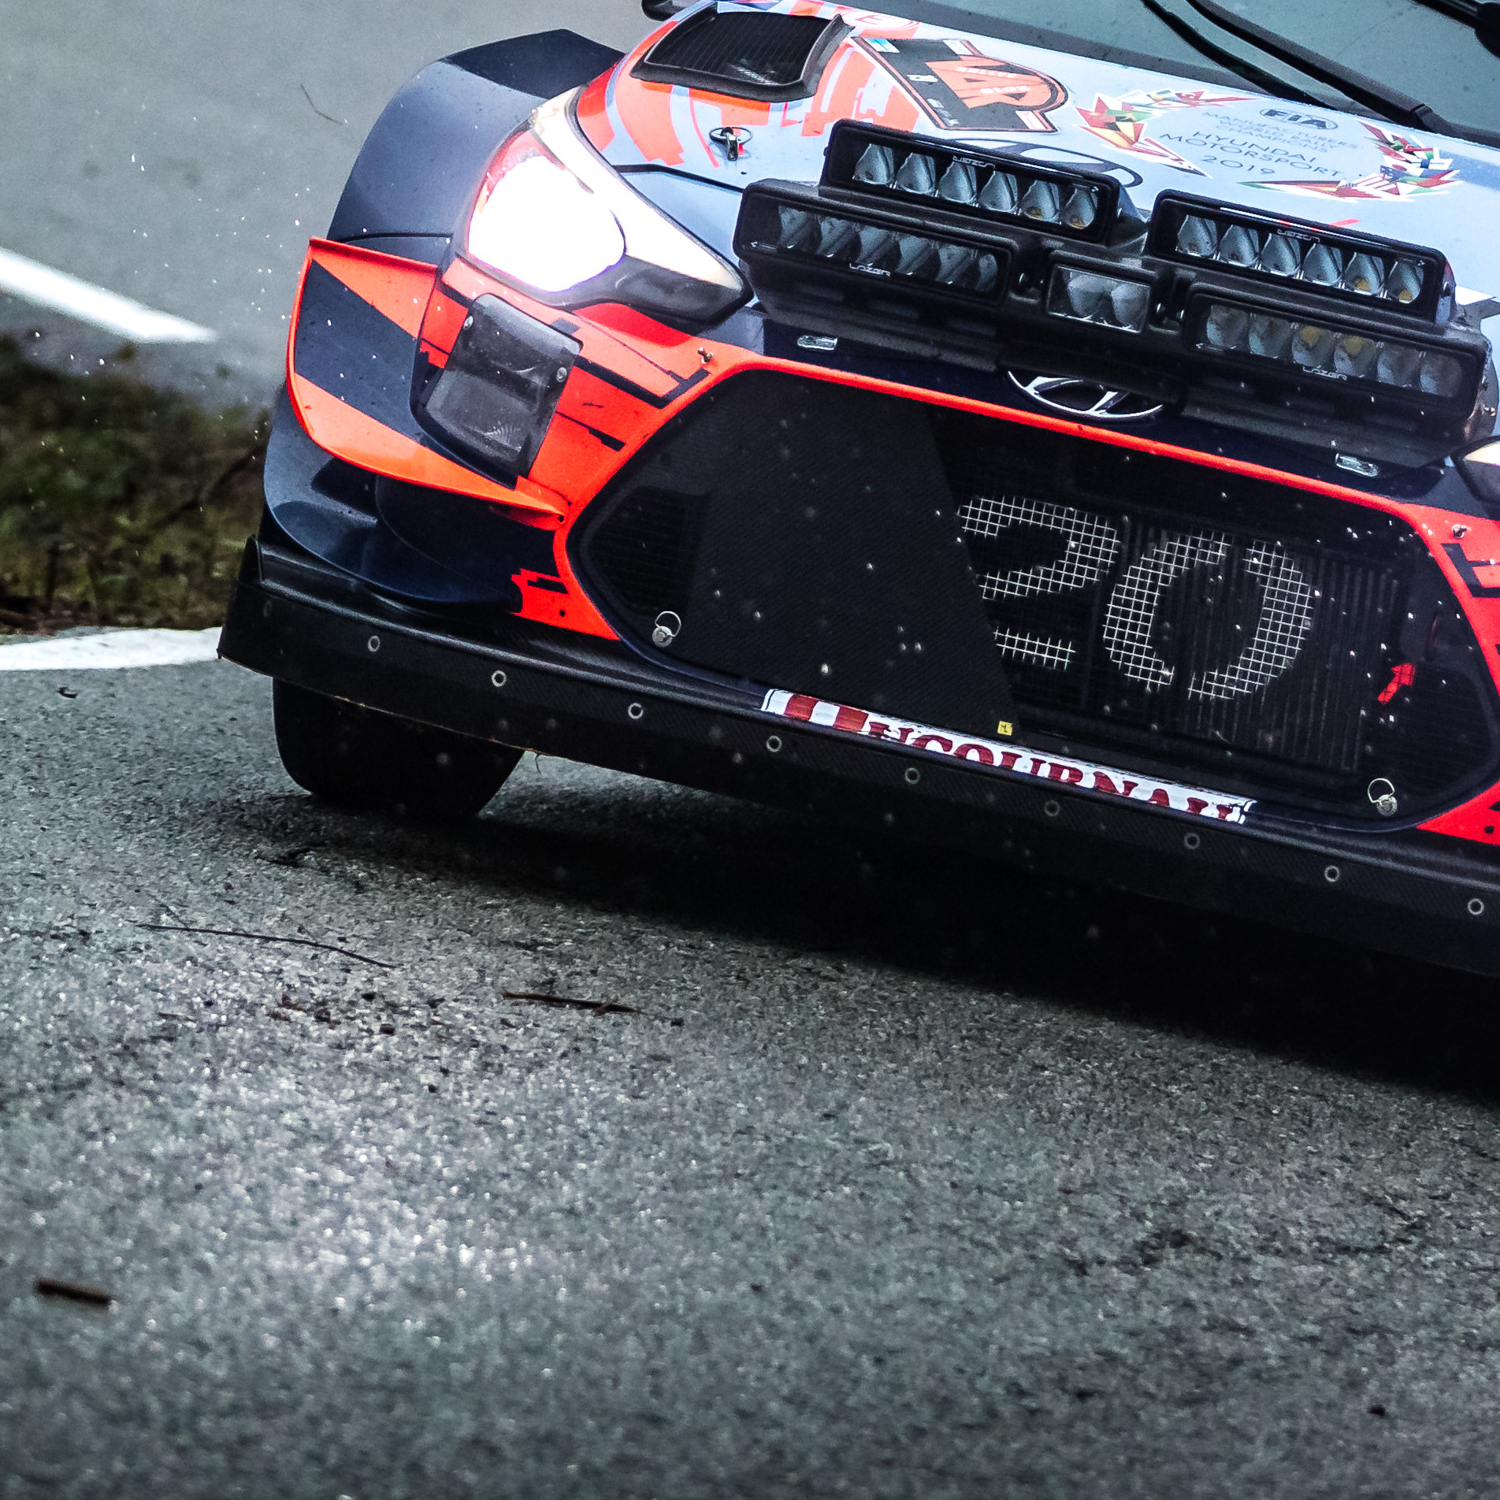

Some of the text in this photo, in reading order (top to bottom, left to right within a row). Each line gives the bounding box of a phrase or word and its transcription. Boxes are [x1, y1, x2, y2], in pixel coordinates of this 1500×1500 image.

[1264, 108, 1327, 129] FIA
[1159, 133, 1345, 177] MOTORSPORT
[1192, 131, 1317, 163] HYUNDAI
[1201, 155, 1276, 175] 2019
